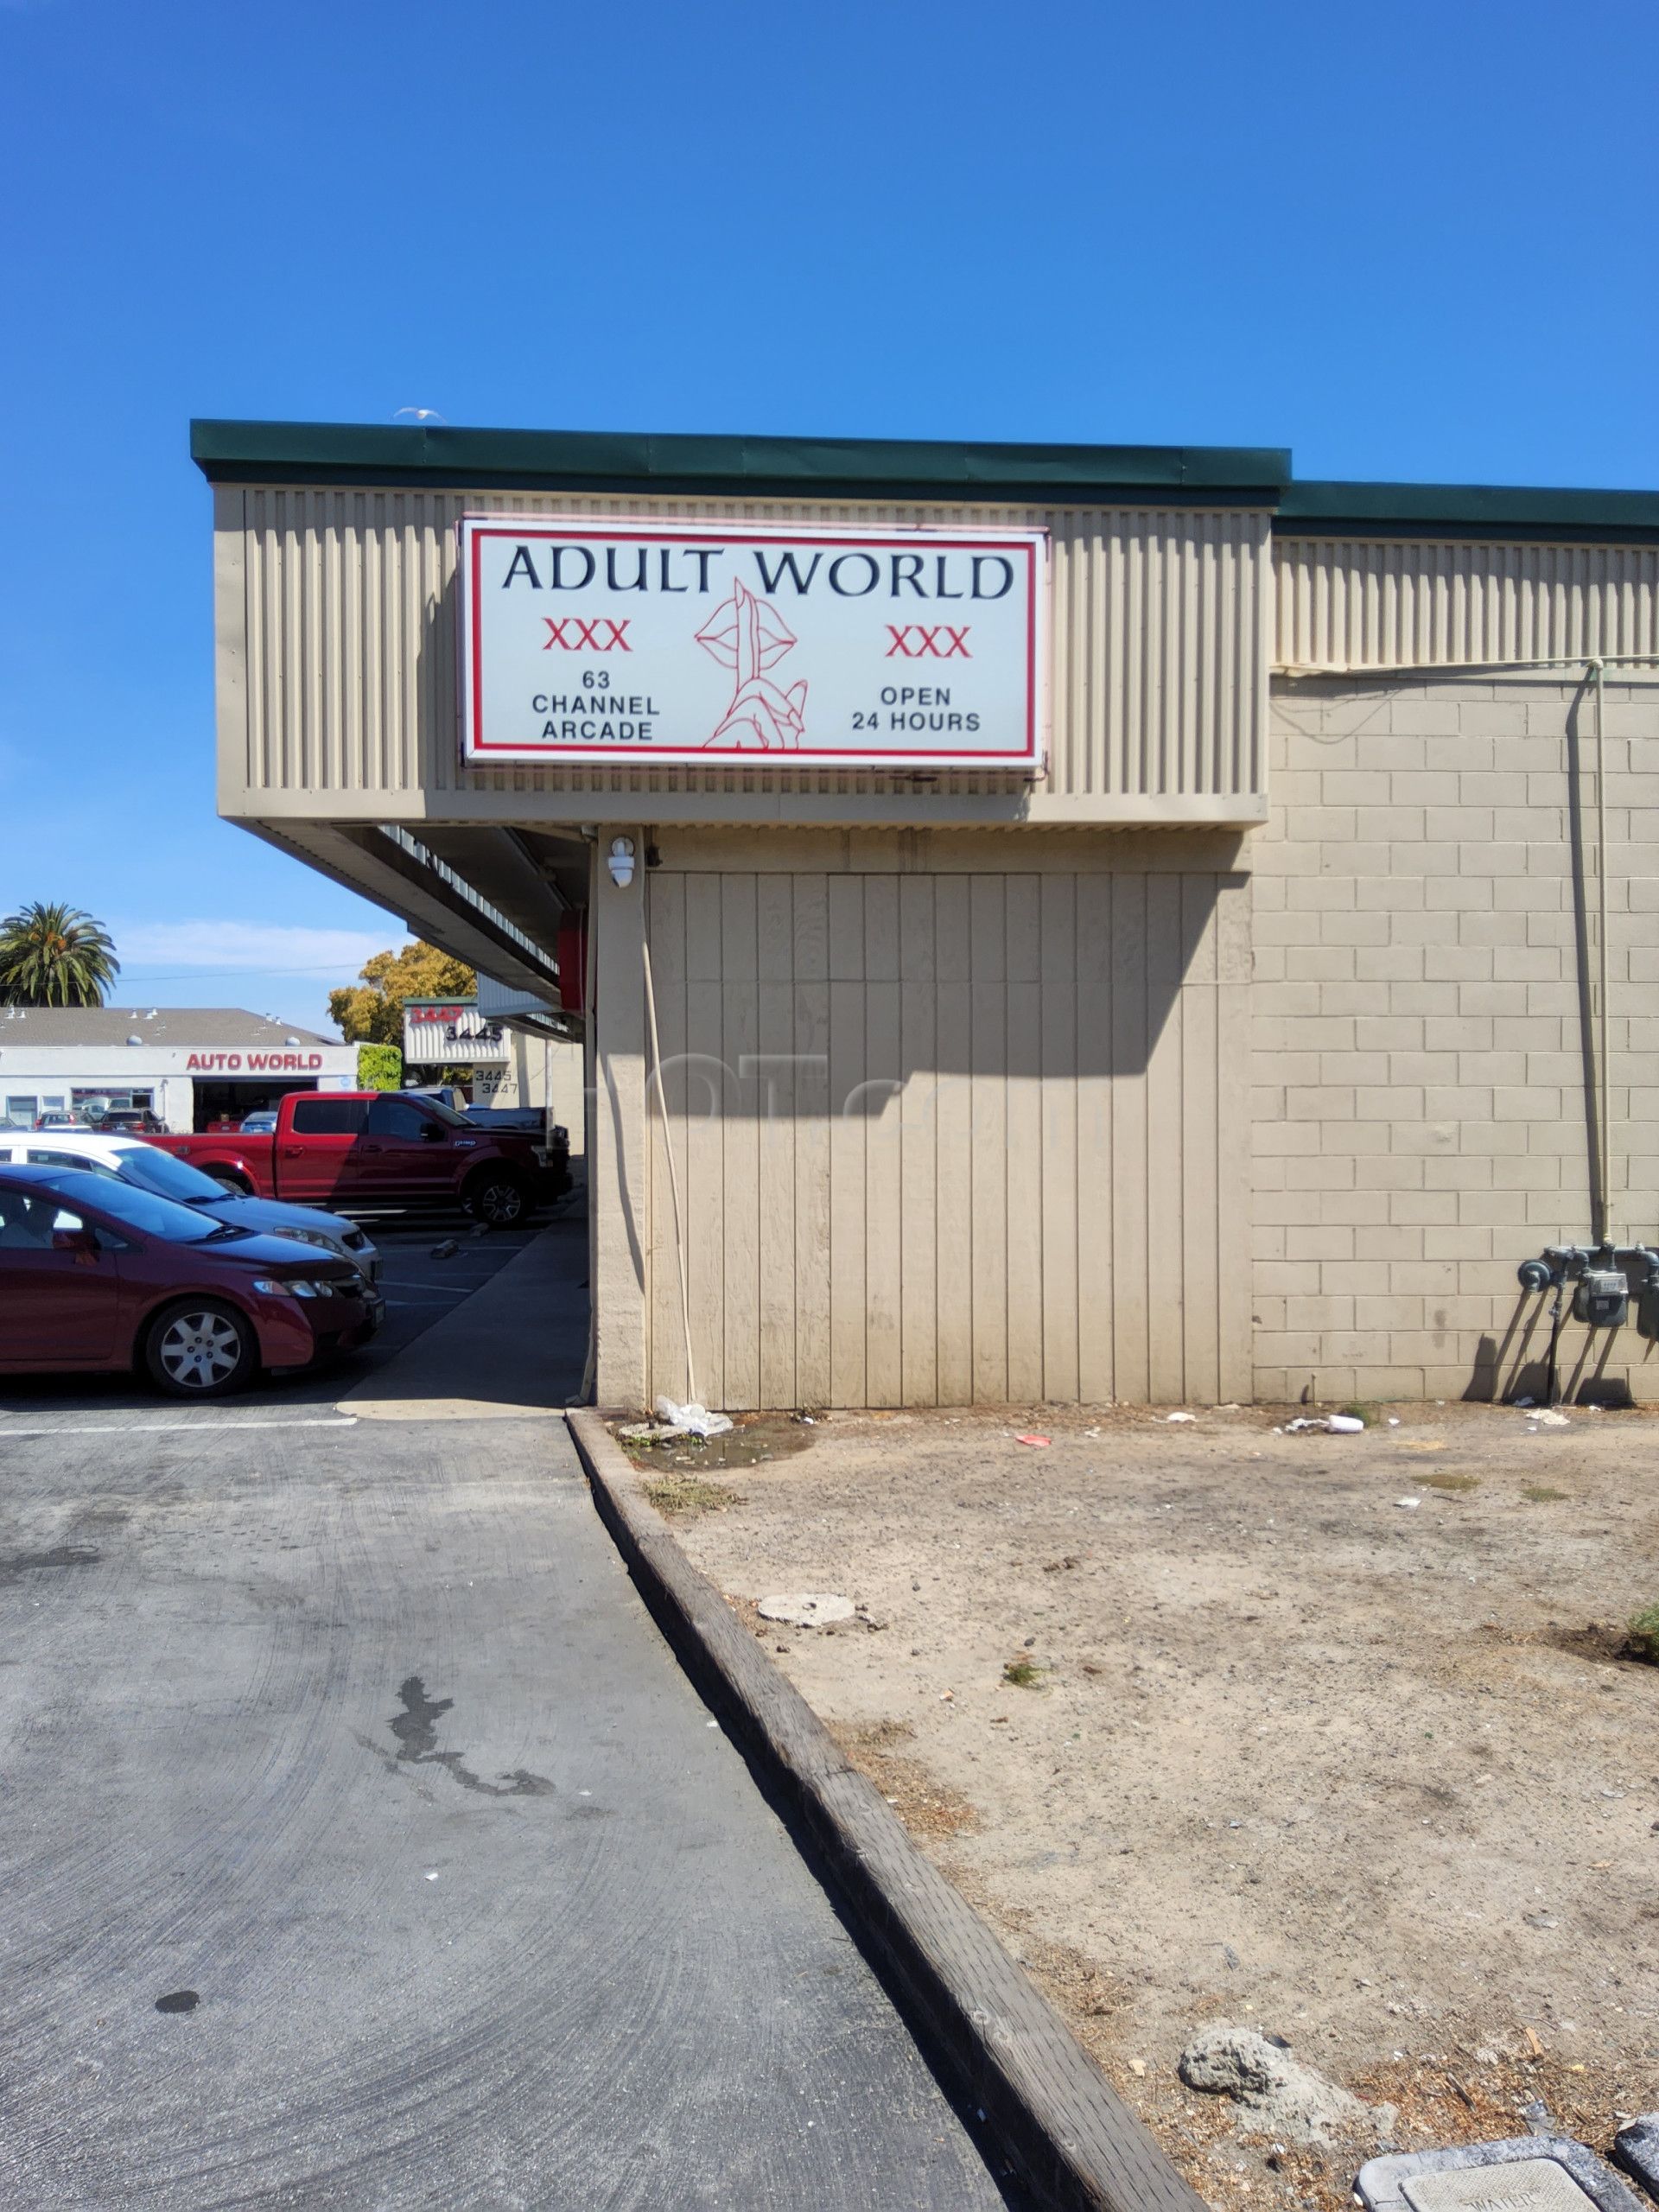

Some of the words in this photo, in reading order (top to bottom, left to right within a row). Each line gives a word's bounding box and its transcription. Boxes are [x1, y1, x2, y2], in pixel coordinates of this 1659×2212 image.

[502, 544, 725, 593] ADULT
[753, 550, 1015, 600] WORLD
[541, 618, 633, 652] XXX
[885, 625, 973, 658] XXX
[582, 670, 611, 690] 63
[531, 694, 660, 715] CHANNEL
[880, 686, 951, 707] OPEN
[541, 720, 653, 741] ARCADE
[851, 711, 880, 731] 24
[890, 712, 981, 733] HOURS
[410, 1006, 464, 1023] 3447
[446, 1021, 503, 1041] 3445
[186, 1053, 243, 1071] AUTO
[247, 1053, 323, 1071] WORLD
[475, 1070, 512, 1081] 3445
[481, 1083, 518, 1095] 3447
